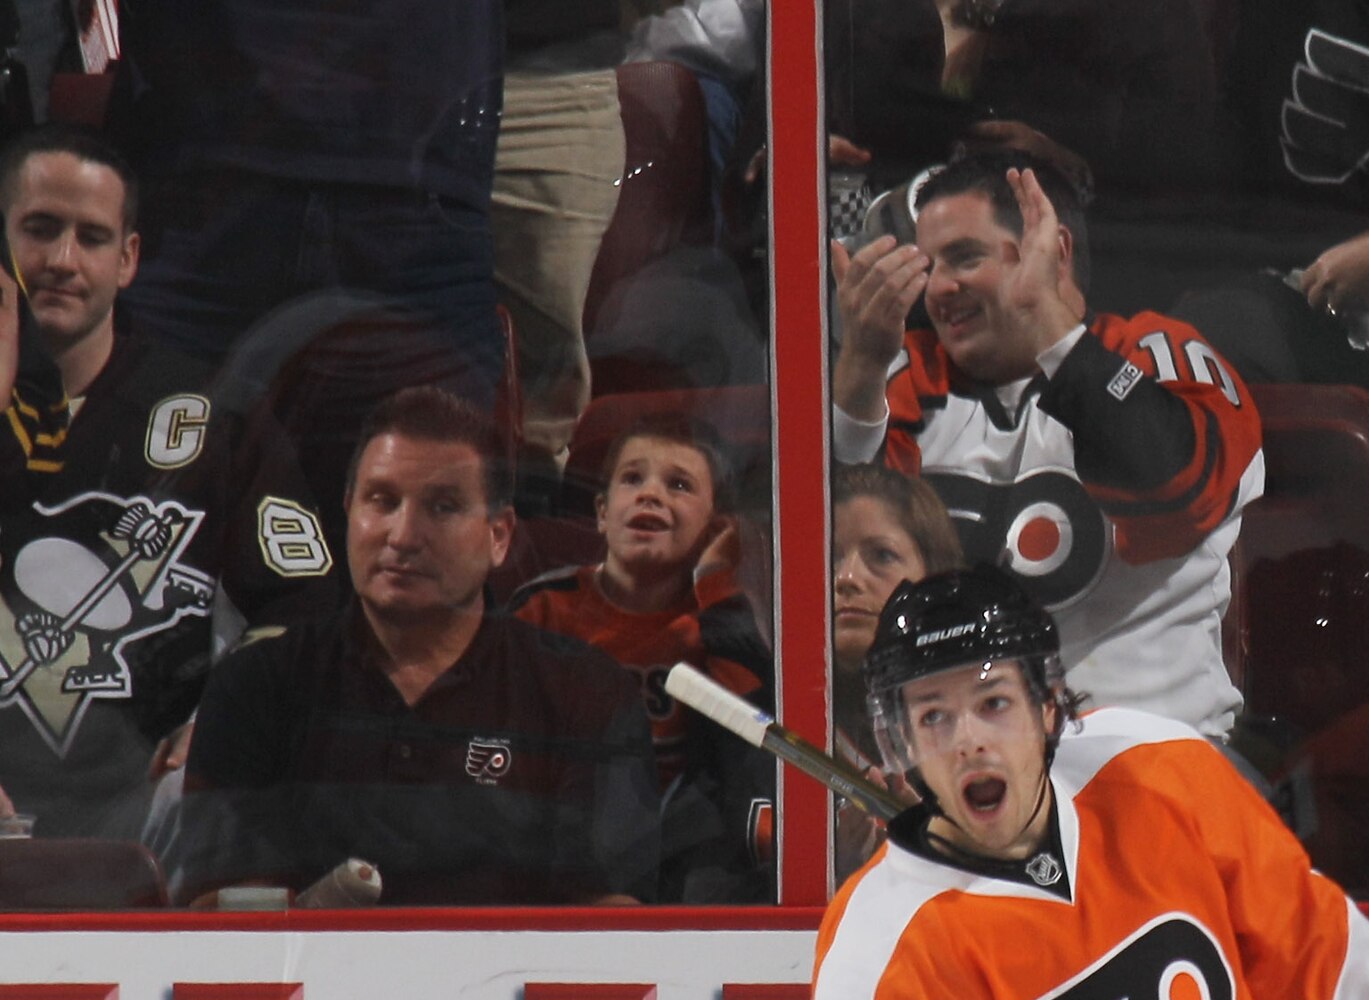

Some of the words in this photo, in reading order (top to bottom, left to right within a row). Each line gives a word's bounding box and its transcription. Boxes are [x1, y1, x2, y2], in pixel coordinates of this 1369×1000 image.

[1109, 361, 1142, 399] CM
[1138, 331, 1240, 406] 10
[144, 393, 211, 470] C
[257, 496, 333, 578] 8
